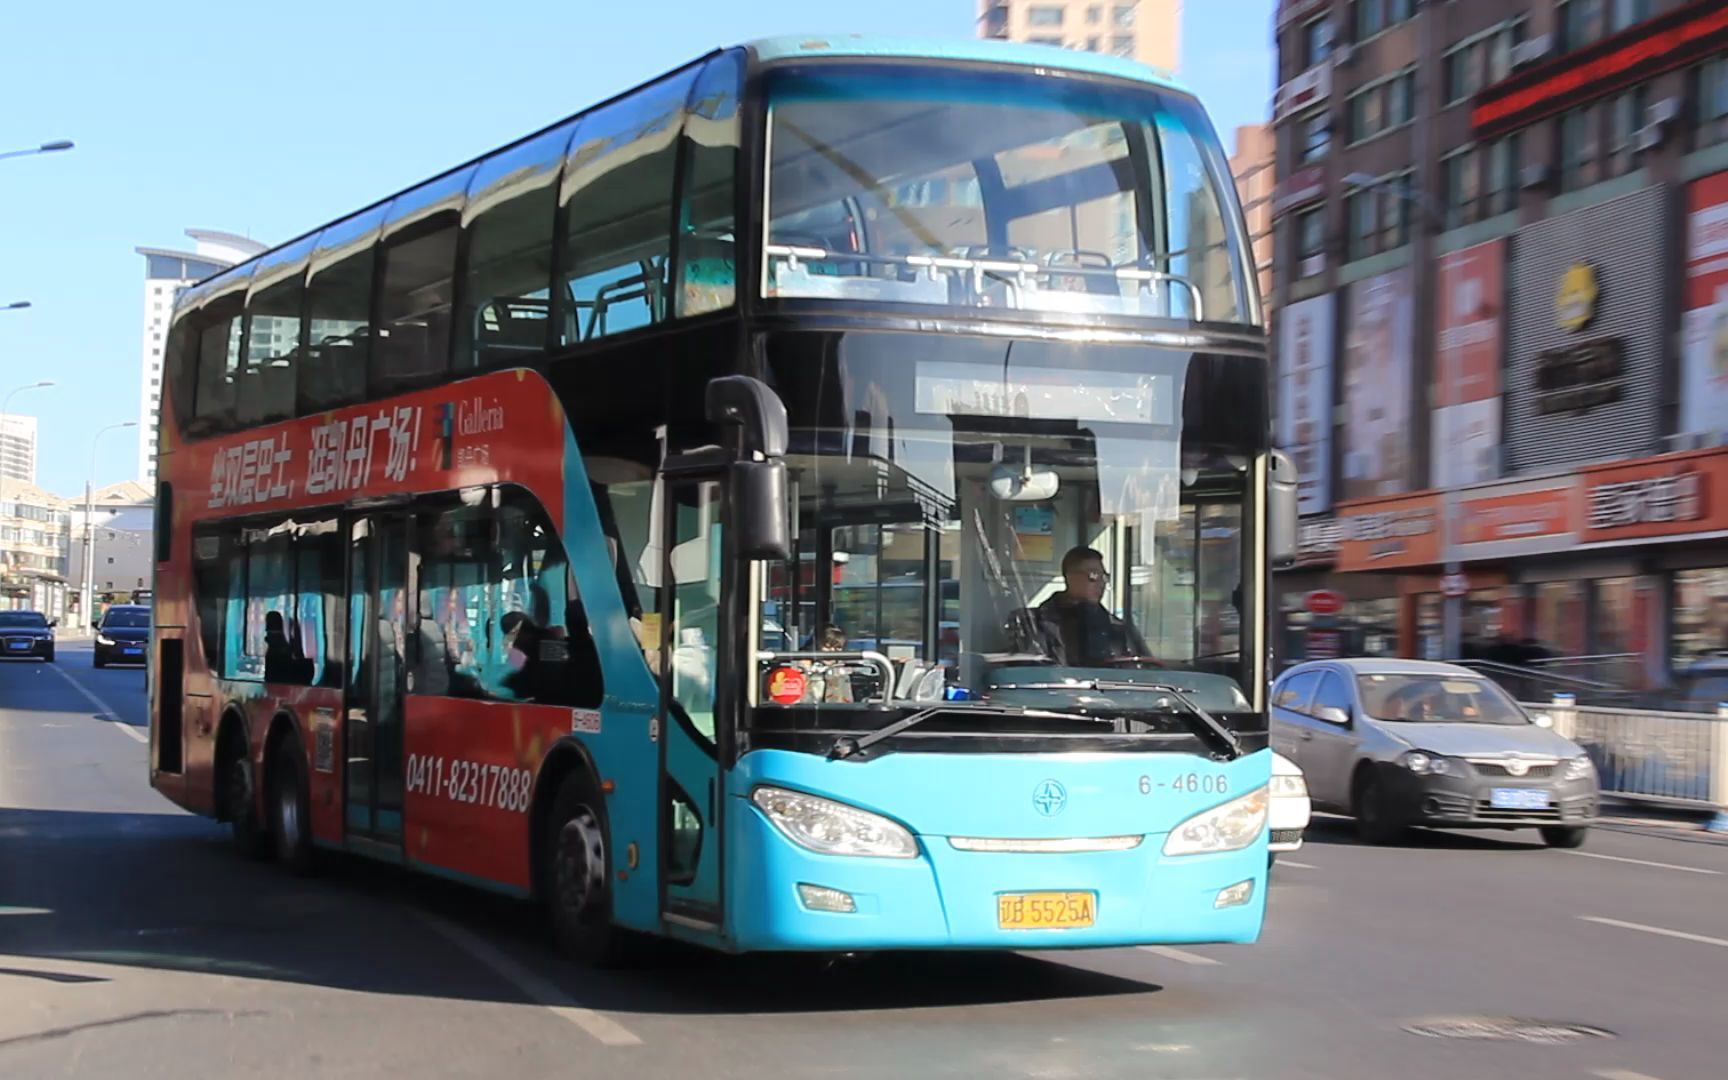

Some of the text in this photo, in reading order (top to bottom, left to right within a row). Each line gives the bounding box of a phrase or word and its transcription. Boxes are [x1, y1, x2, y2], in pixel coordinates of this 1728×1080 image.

[458, 397, 504, 436] Galleria
[406, 753, 531, 813] 0411-82317888
[1138, 772, 1228, 795] 6-4606
